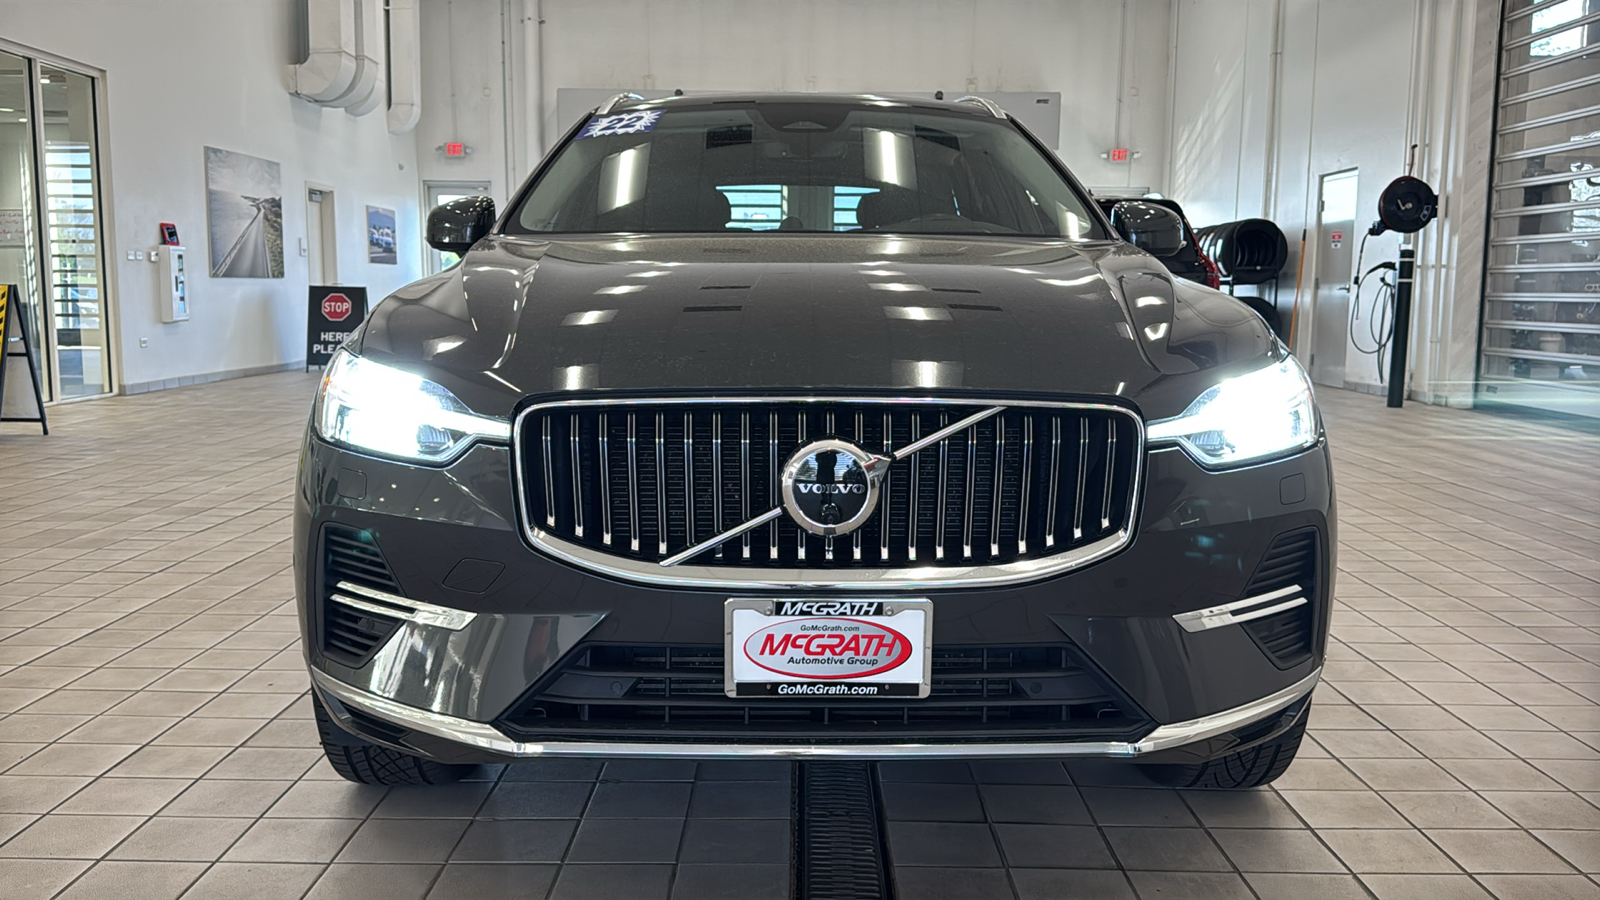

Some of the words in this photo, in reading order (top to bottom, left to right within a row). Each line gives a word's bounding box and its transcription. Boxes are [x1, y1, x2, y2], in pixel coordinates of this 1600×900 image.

[597, 115, 645, 132] 22
[446, 142, 462, 155] EXIT
[1112, 148, 1127, 161] EXIT
[323, 302, 350, 313] STOP
[796, 483, 865, 494] VOLVO
[800, 624, 860, 632] GoMcGrath.com
[787, 656, 845, 665] Automotive
[847, 657, 879, 667] Group
[777, 684, 877, 695] GoMcGrath.com
